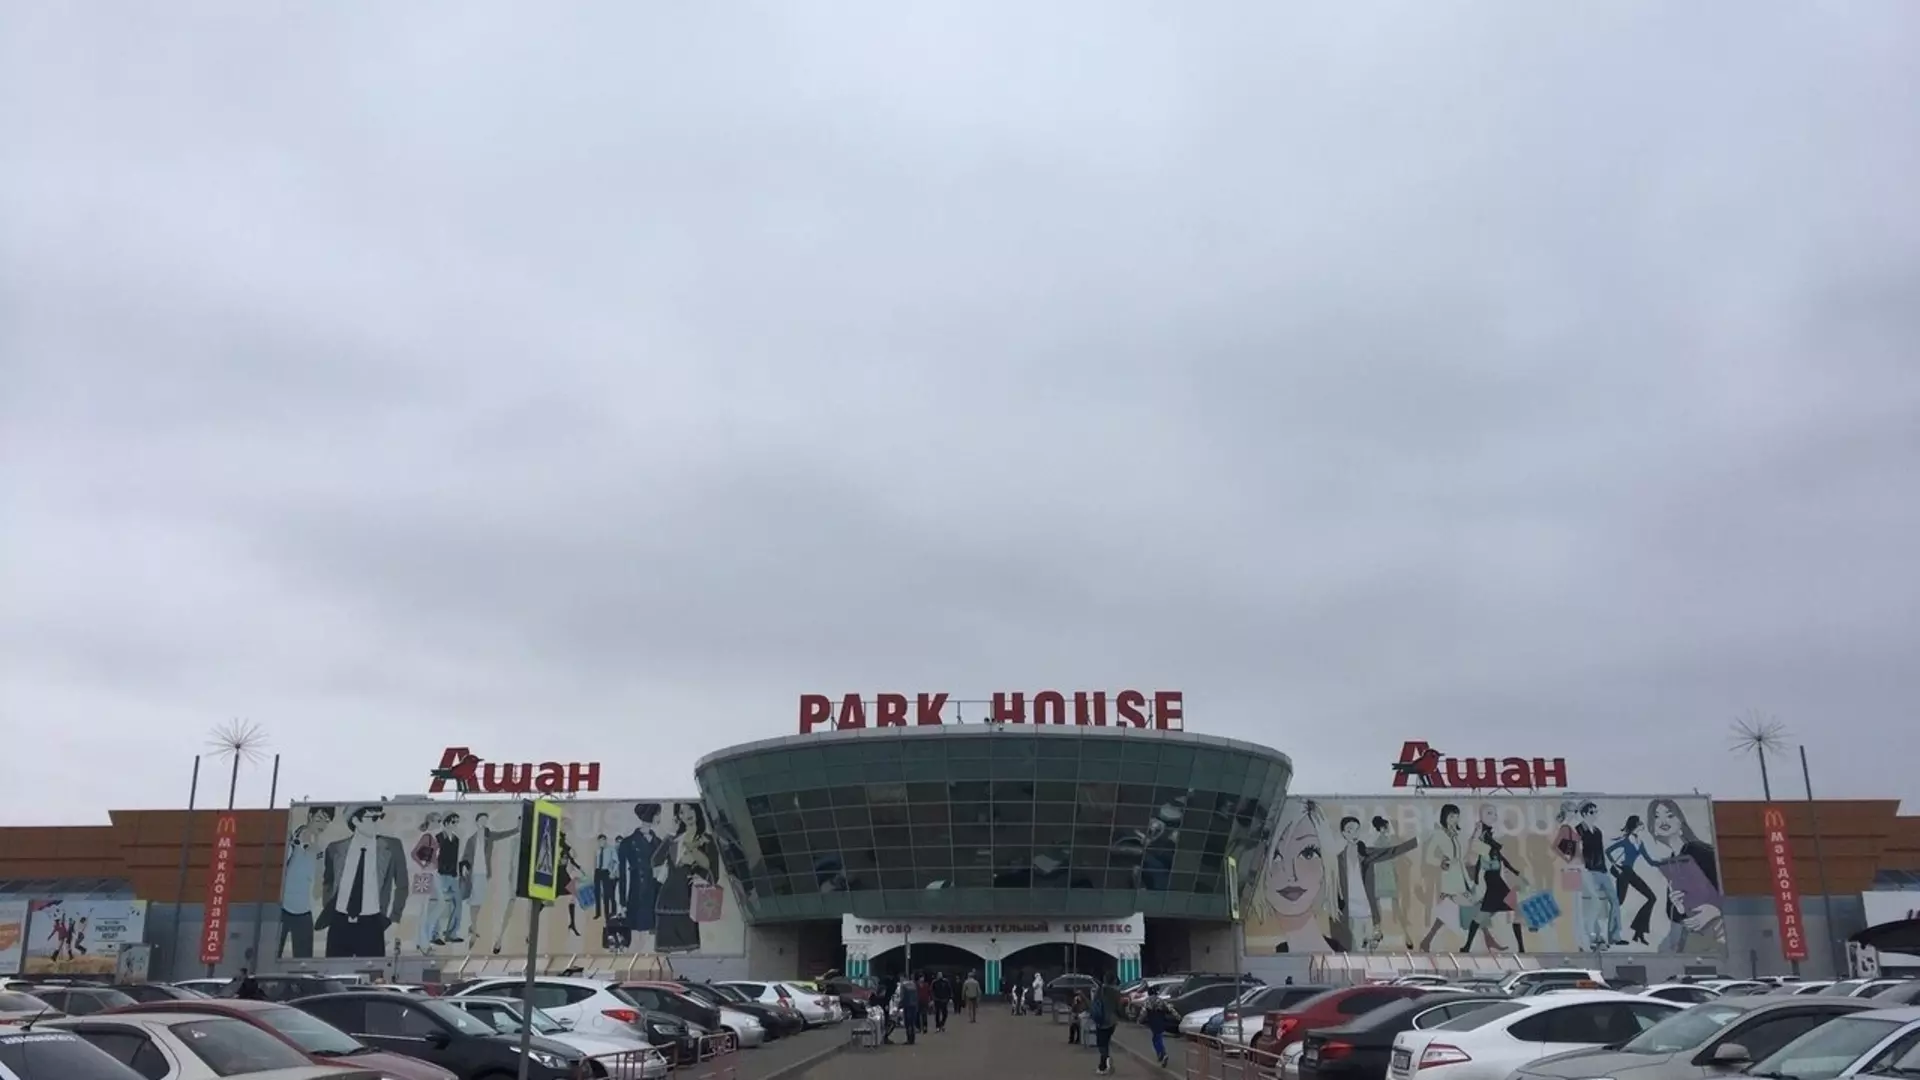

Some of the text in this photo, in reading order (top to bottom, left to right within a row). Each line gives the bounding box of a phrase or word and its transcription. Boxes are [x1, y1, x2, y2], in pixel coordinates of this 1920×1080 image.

[800, 690, 1184, 734] PARK HOUSE
[429, 747, 600, 793] Ашан
[1393, 741, 1567, 788] Ашан
[855, 924, 912, 934] ТОРГОВО
[930, 922, 1049, 934] РАЗВЛЕКАТЕЛЬНЫЙ
[1063, 923, 1132, 933] КОМПЛЕКС
